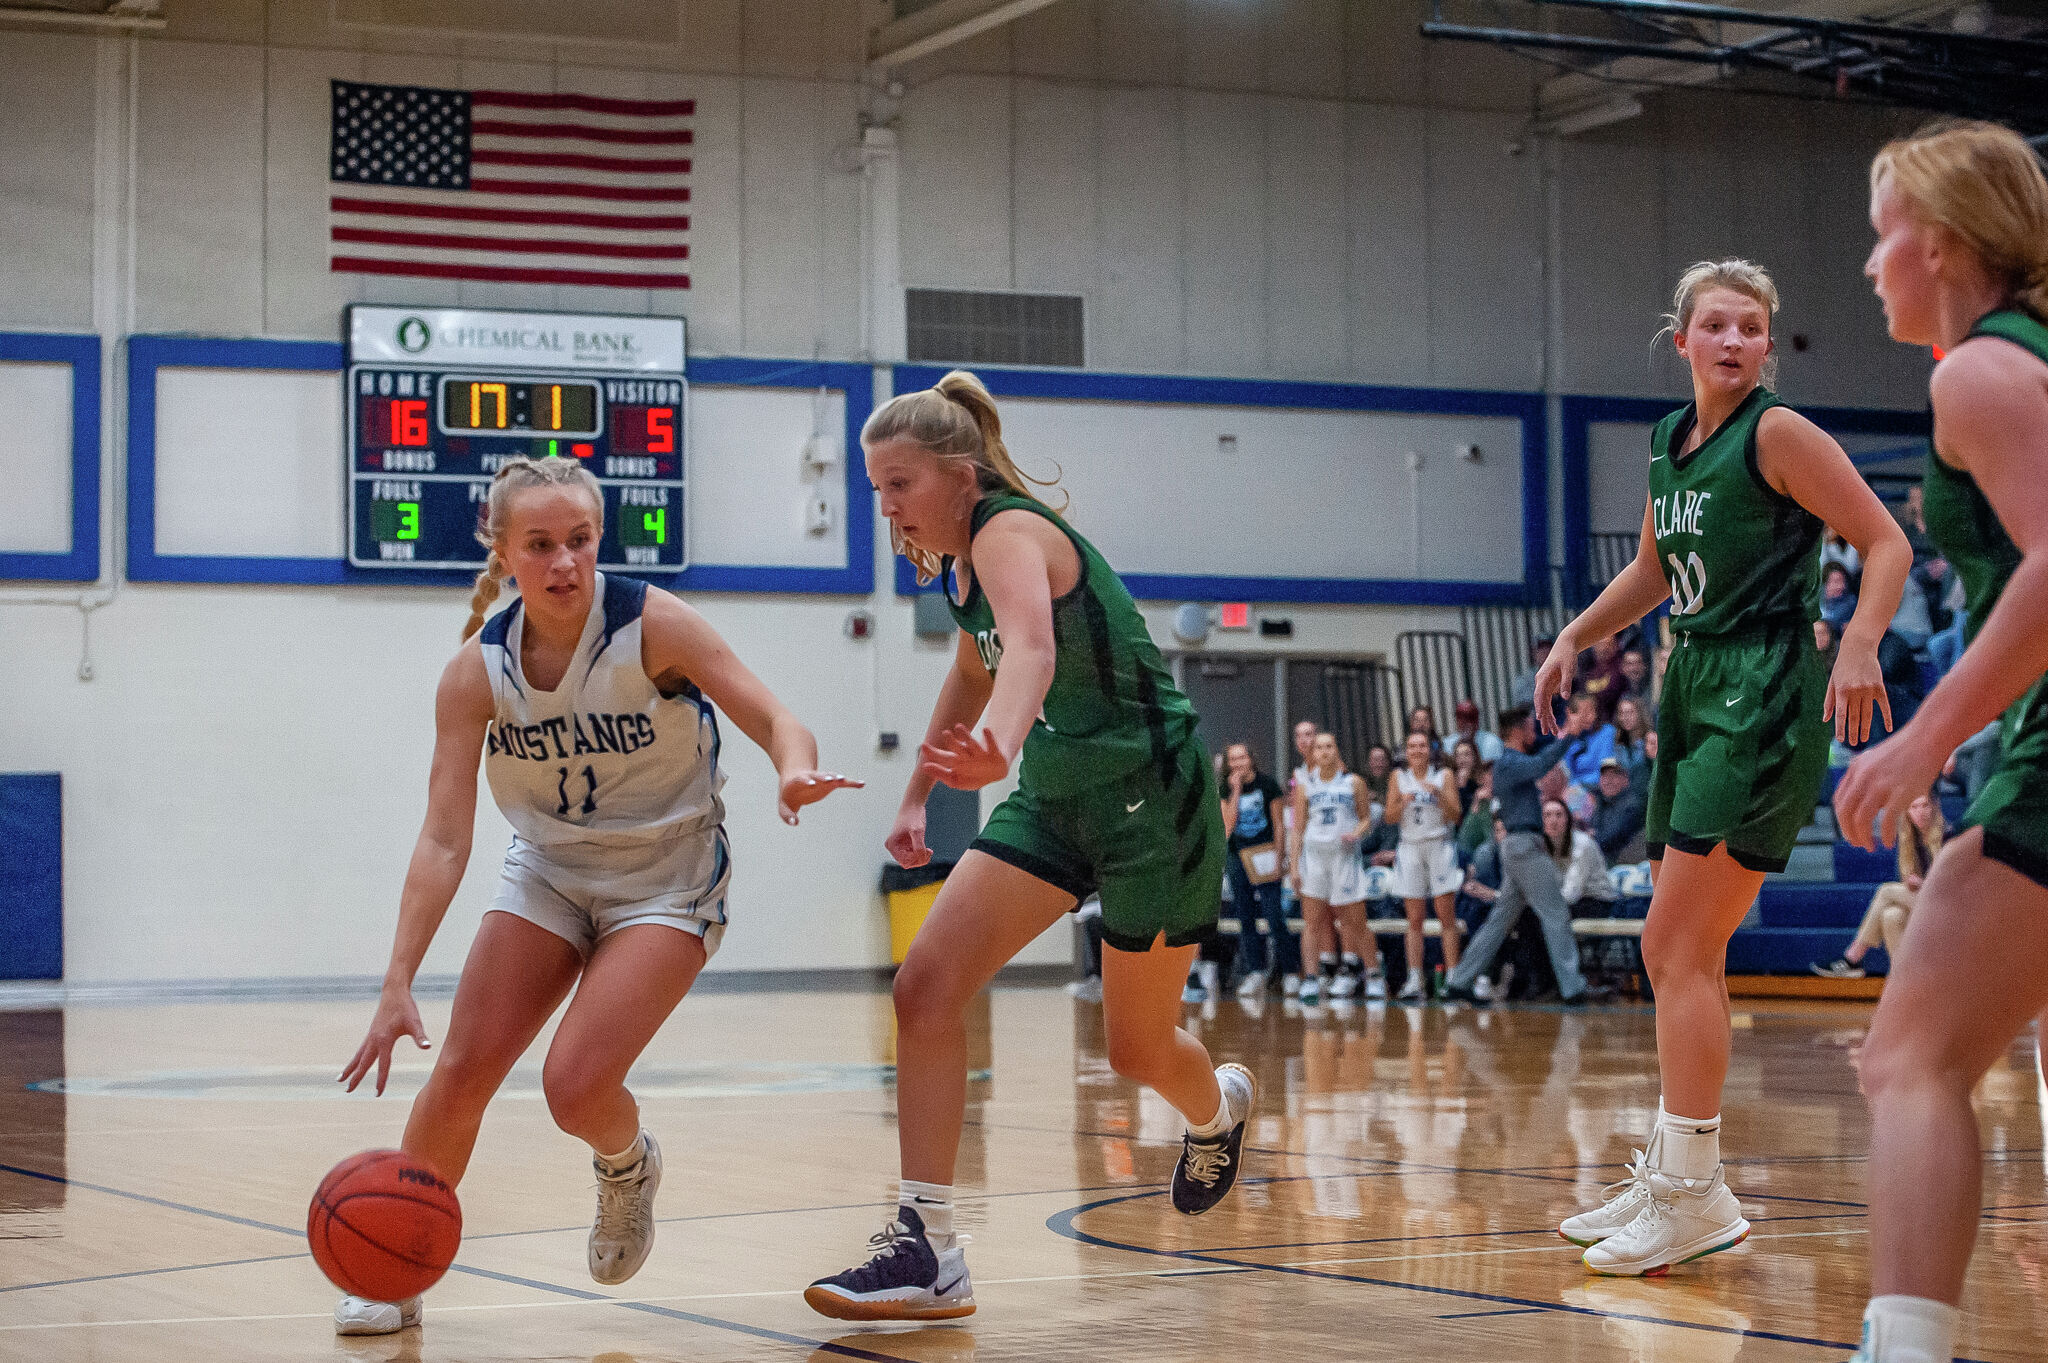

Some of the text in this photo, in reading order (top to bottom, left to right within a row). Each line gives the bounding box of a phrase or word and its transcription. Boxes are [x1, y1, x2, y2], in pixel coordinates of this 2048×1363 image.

[439, 327, 563, 352] CHEMICAL
[360, 372, 432, 397] HOME
[606, 382, 681, 405] VISITOR
[391, 400, 428, 446] 16
[647, 408, 673, 453] 5
[382, 450, 436, 472] BONUS
[605, 455, 657, 478] BONUS
[371, 481, 422, 501] FOULS
[620, 487, 669, 506] FOULS
[396, 502, 420, 539] 3
[644, 508, 666, 544] 4
[1653, 490, 1712, 541] CLARE
[1668, 551, 1707, 616] 10
[486, 711, 656, 762] MUSTANGS
[556, 764, 598, 815] 11
